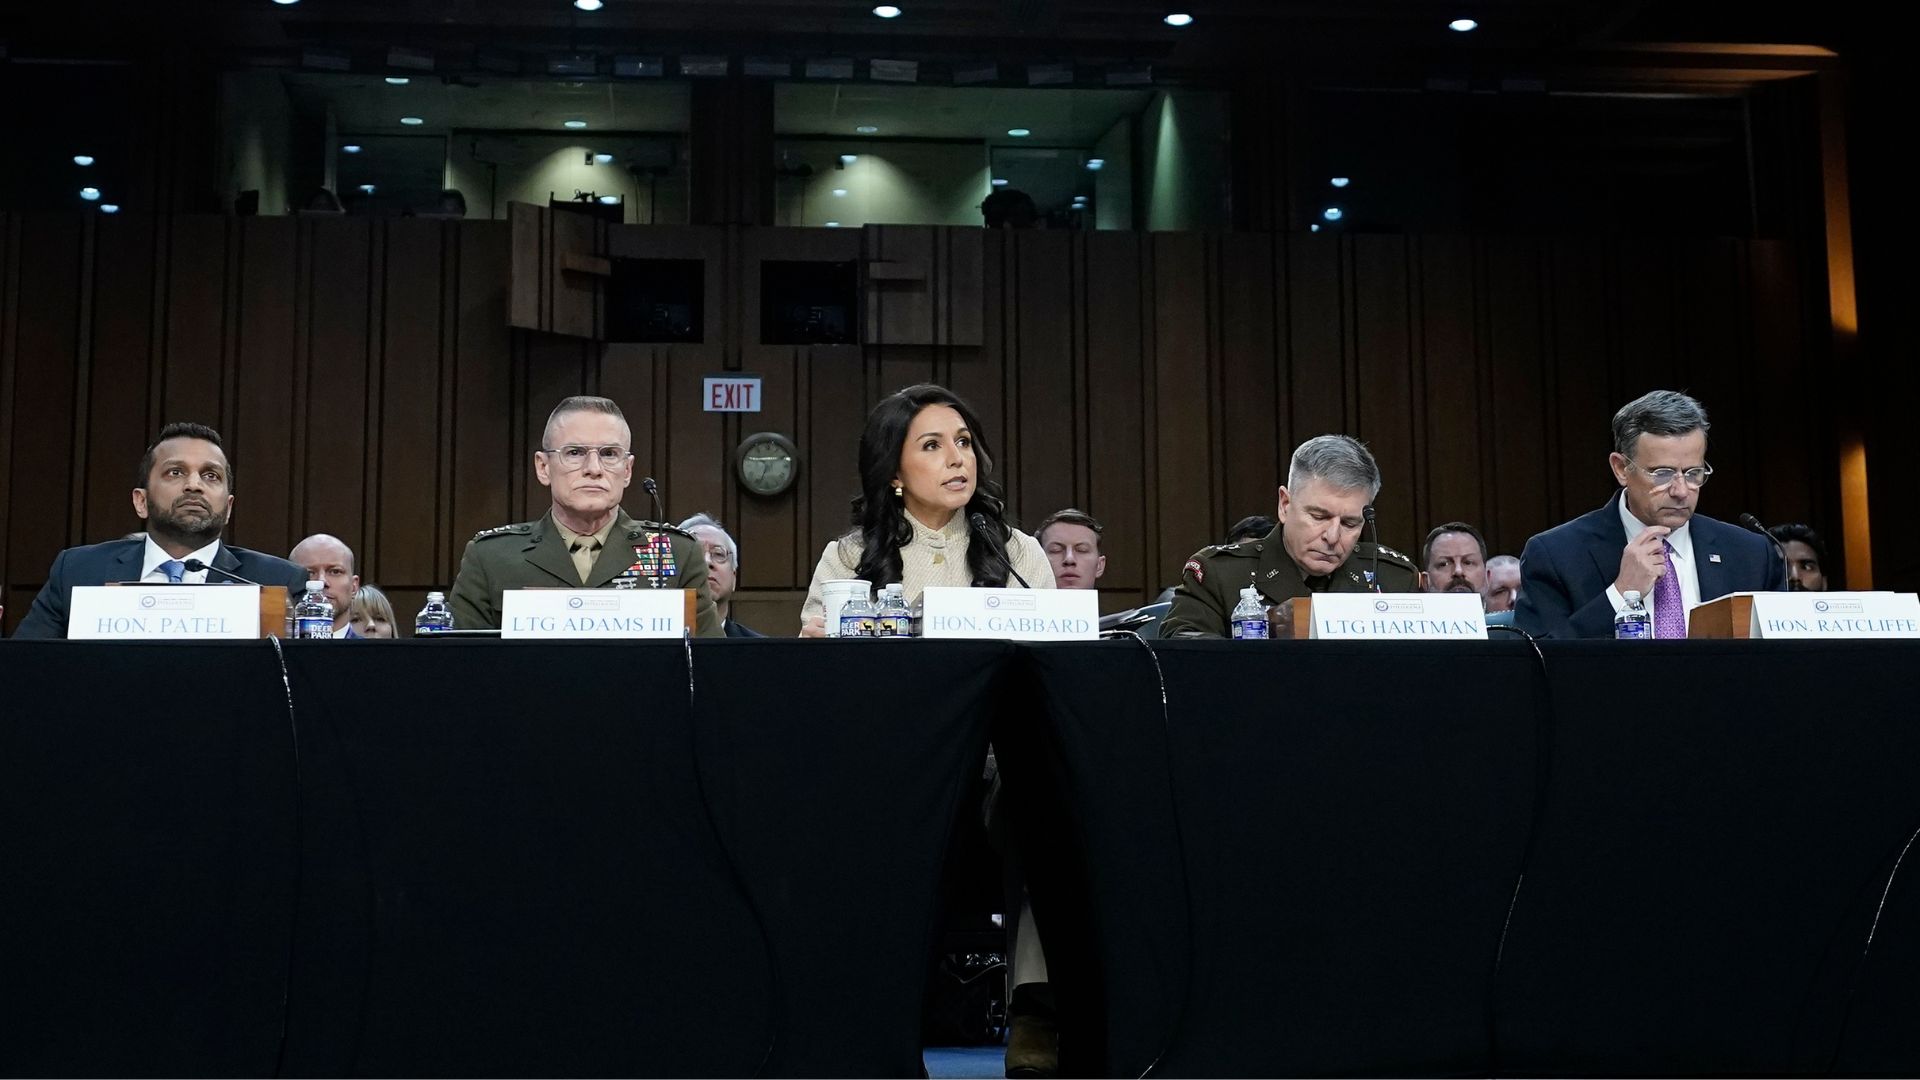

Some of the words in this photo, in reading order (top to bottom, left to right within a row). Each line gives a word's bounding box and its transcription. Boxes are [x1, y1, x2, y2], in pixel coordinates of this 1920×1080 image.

[712, 383, 754, 409] EXIT
[97, 616, 154, 634] HON.
[160, 616, 233, 634] PATEL
[311, 624, 333, 632] DEER
[513, 616, 555, 632] LTG
[562, 616, 644, 632] ADAMS
[652, 616, 672, 632] III
[841, 621, 860, 629] DEER
[933, 615, 982, 632] HON.
[988, 616, 1090, 634] GABBARD
[1326, 619, 1365, 634] LTG
[1373, 619, 1479, 635] HARTMAN
[1768, 619, 1813, 632] HON.
[1818, 619, 1918, 632] RATCLIFFE
[310, 631, 333, 640] PARK
[841, 628, 861, 636] PARK
